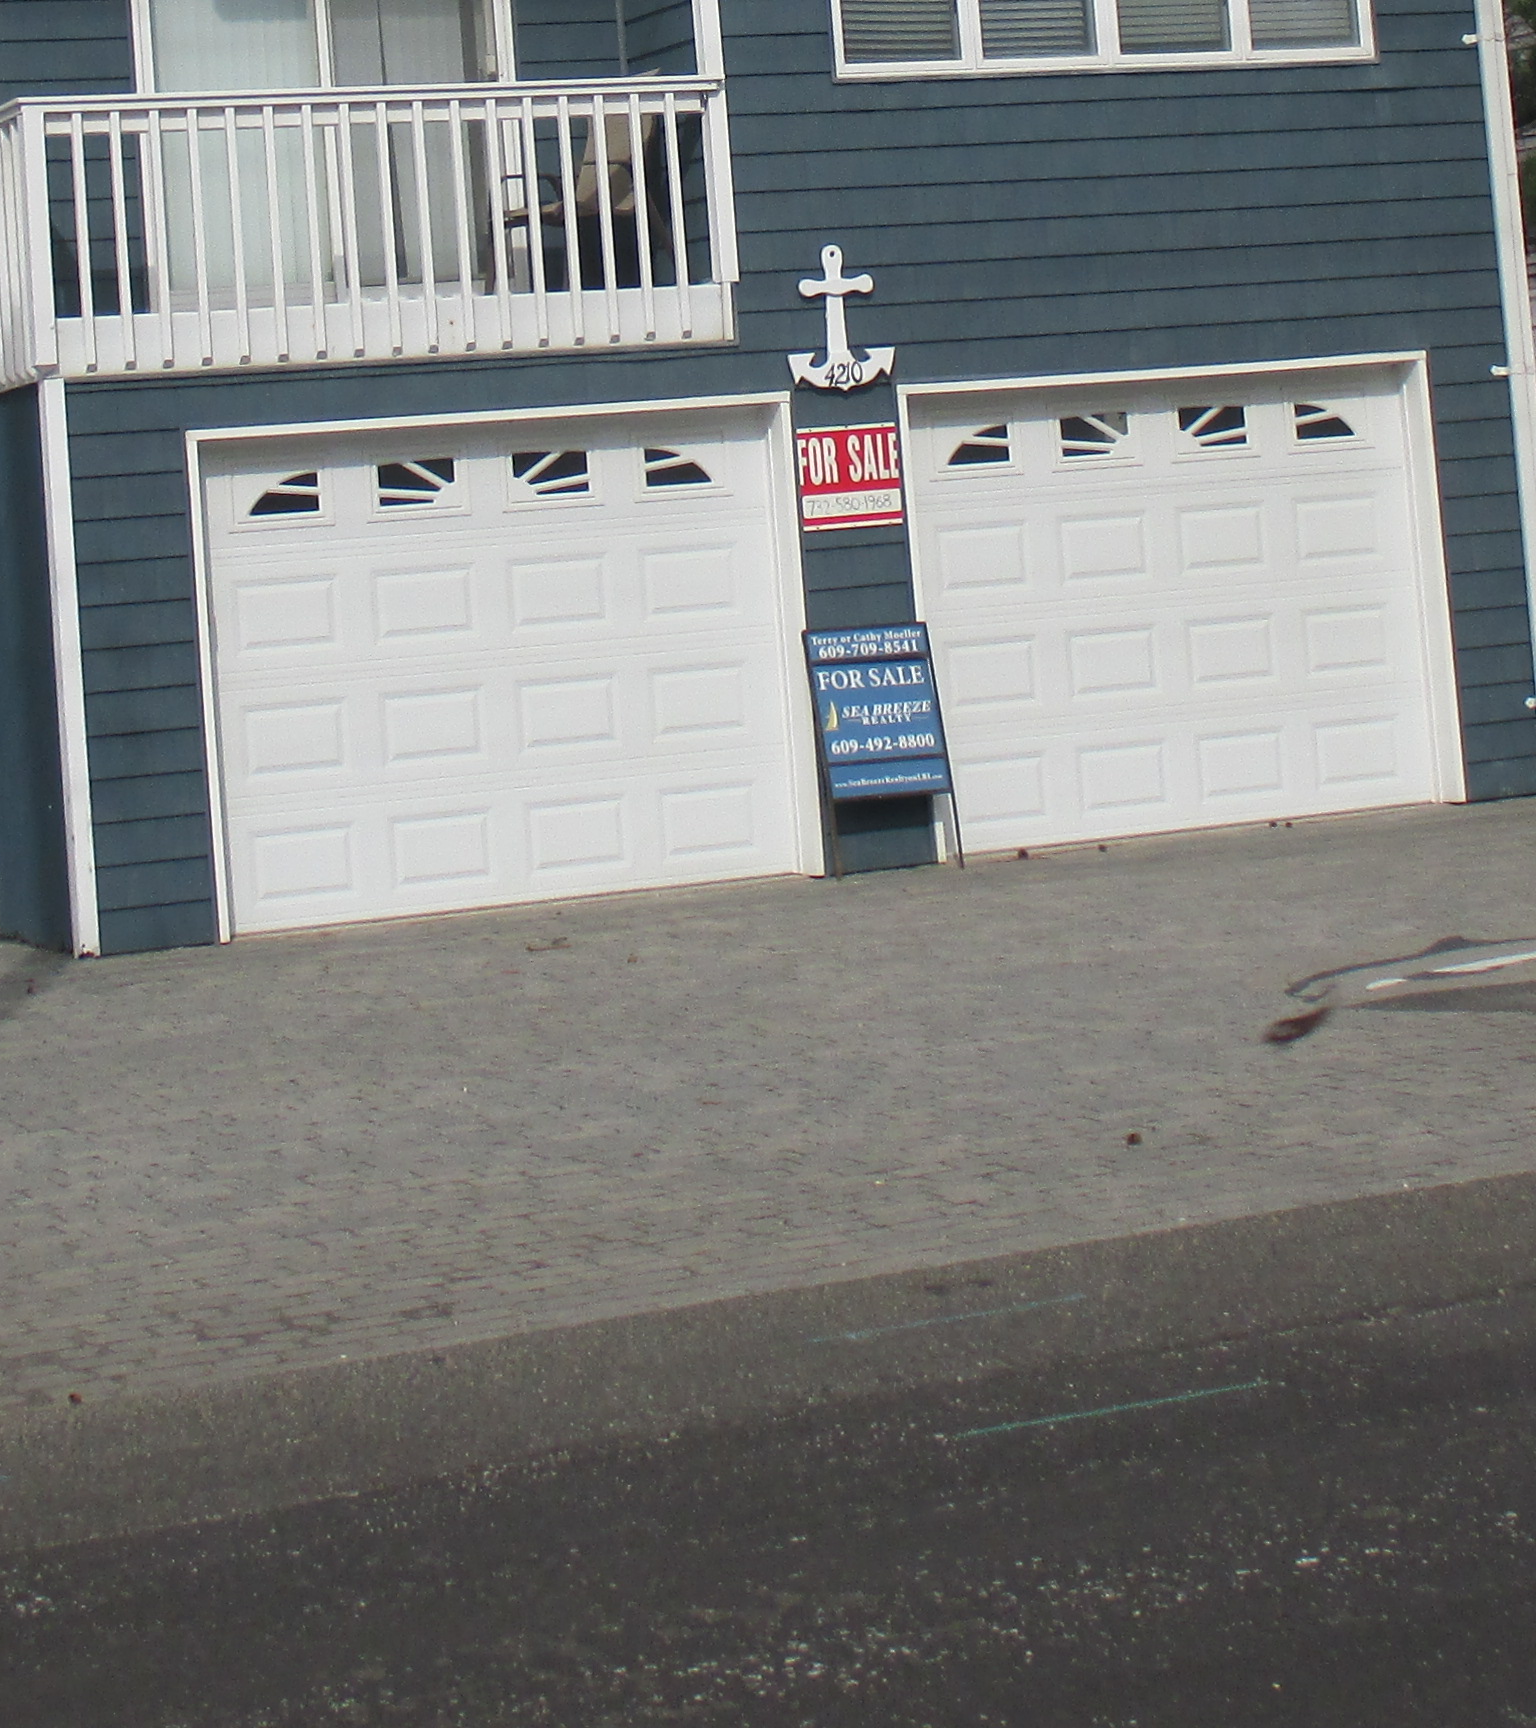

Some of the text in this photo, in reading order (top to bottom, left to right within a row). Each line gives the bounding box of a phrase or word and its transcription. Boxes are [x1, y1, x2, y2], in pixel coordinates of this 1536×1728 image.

[824, 361, 863, 387] 4210
[797, 432, 900, 486] FOR SALE
[811, 635, 838, 646] Terry
[840, 635, 851, 643] or
[853, 631, 881, 643] Cathy
[818, 639, 919, 659] 609-709-8541
[817, 665, 925, 691] FOR SALE
[842, 700, 932, 719] SEA BREEZE
[862, 712, 912, 726] REALTY
[831, 732, 935, 755] 609-492-8800
